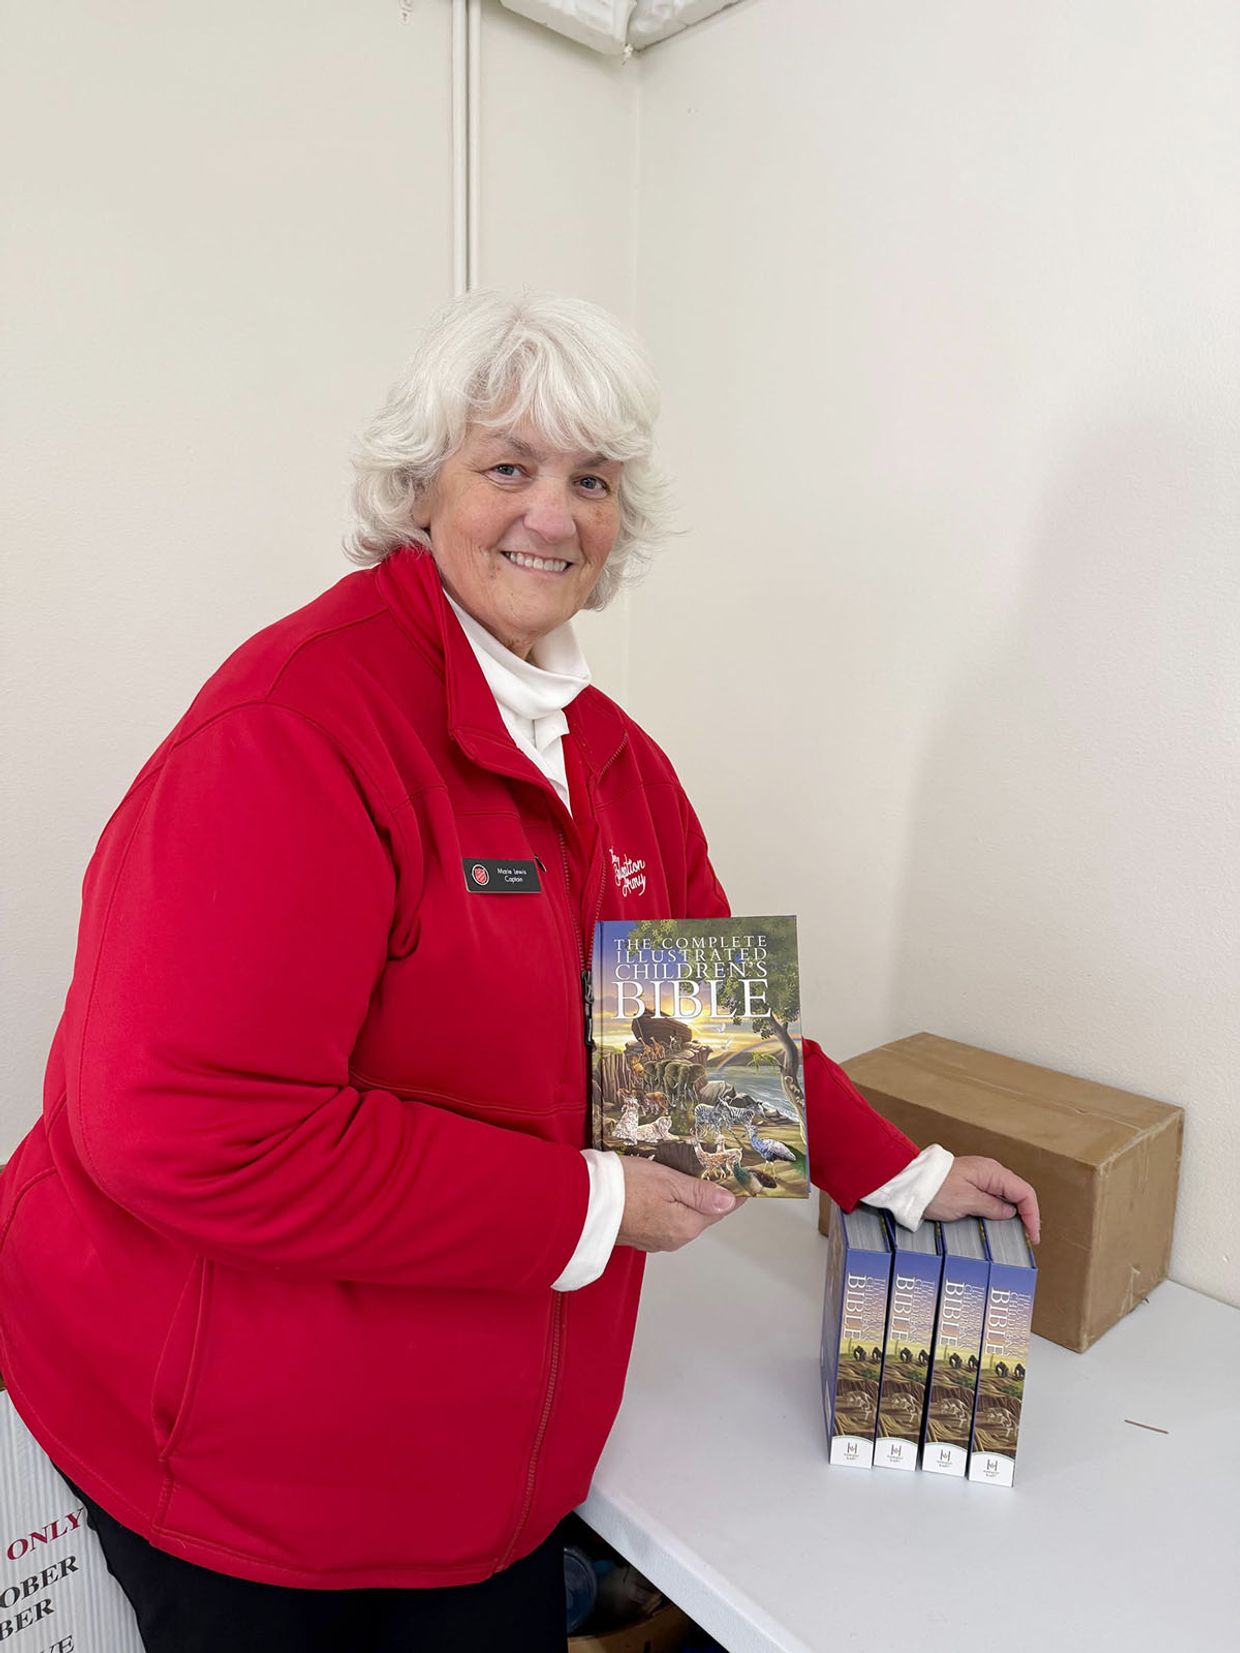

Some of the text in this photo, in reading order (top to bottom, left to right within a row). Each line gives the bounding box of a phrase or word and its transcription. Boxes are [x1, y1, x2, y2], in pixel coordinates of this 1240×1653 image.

[614, 935, 767, 950] THE COMPLETE
[616, 947, 767, 963] ILLUSTRATED
[615, 961, 768, 980] CHILDREN'S
[611, 978, 772, 1021] BIBLE
[843, 1273, 867, 1341] BIBLE
[890, 1274, 915, 1341] BIBLE
[939, 1279, 965, 1347] BIBLE
[985, 1287, 1011, 1356] BIBLE
[7, 1507, 85, 1560] ONLY
